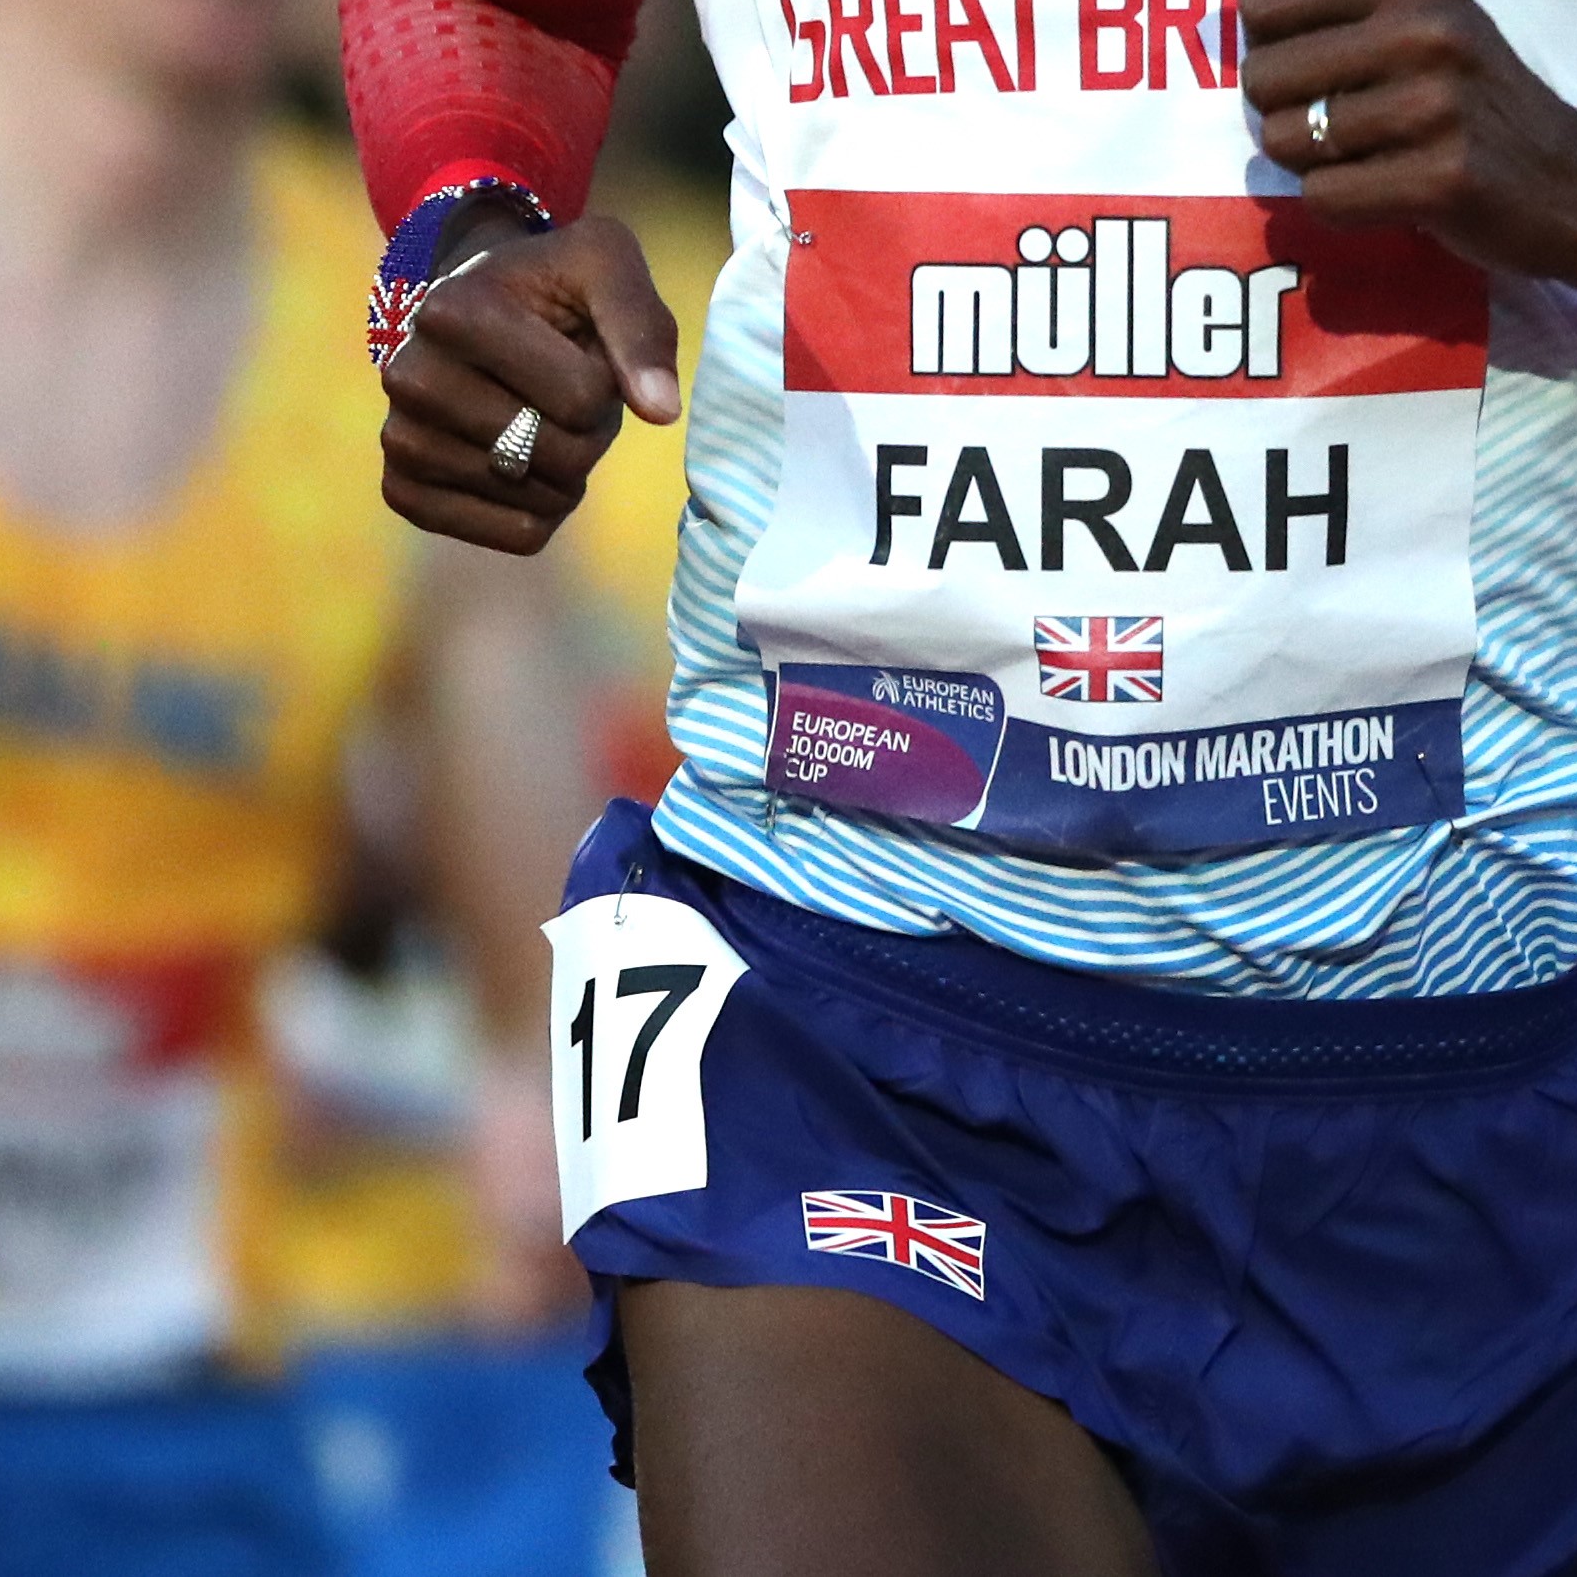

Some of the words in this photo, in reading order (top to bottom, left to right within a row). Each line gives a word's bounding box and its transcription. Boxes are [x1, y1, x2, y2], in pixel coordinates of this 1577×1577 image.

[910, 216, 1302, 380] müller
[868, 442, 1350, 574] FARAH
[902, 674, 995, 707] EUROPEAN
[903, 690, 995, 723] ATHLETICS
[786, 734, 875, 771] 10,000M
[792, 710, 911, 753] EUROPEAN
[1048, 735, 1187, 792] LONDON
[1194, 715, 1394, 784] MARATHON
[785, 758, 828, 784] CUP
[1262, 767, 1379, 826] EVENTS
[570, 963, 708, 1143] 17
